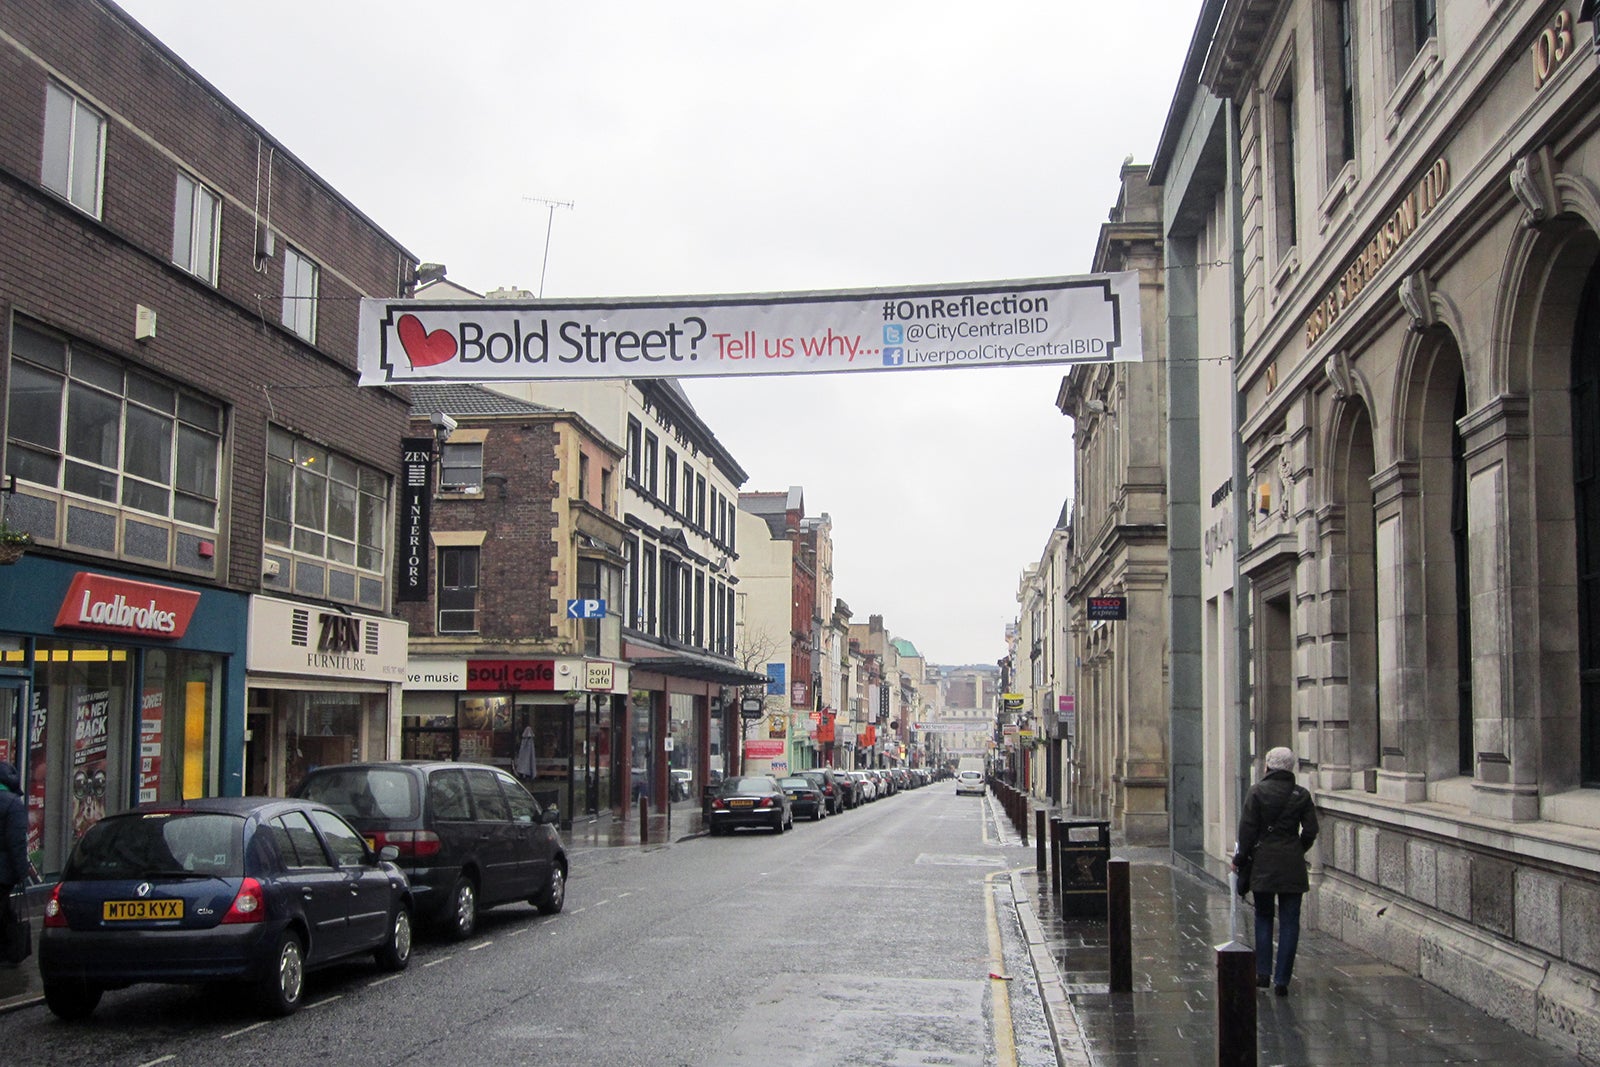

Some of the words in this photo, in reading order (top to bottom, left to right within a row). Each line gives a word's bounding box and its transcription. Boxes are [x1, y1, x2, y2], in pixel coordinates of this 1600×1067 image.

[1531, 9, 1573, 91] 103
[882, 294, 1049, 321] #OnReflection
[459, 319, 548, 363] Bold
[558, 316, 707, 363] Street?
[712, 331, 757, 360] Tell
[764, 336, 794, 359] us
[800, 328, 880, 362] why...
[906, 317, 1049, 343] @CityCentralBID
[906, 338, 1104, 365] LiverpoolCityCentralBID
[404, 451, 430, 462] ZEN
[408, 495, 421, 587] INTERIORS
[79, 589, 176, 632] Ladbrokes
[584, 599, 599, 618] P
[318, 613, 361, 653] ZEN
[307, 653, 366, 672] FURNITURE
[468, 664, 508, 681] soul
[513, 663, 553, 681] cafe
[589, 667, 610, 676] soul
[407, 673, 421, 683] ve
[424, 671, 459, 683] music
[589, 676, 610, 685] cafe
[75, 716, 108, 740] BACK
[109, 903, 145, 917] MT03
[149, 902, 177, 916] KYX
[196, 907, 214, 915] Clio
